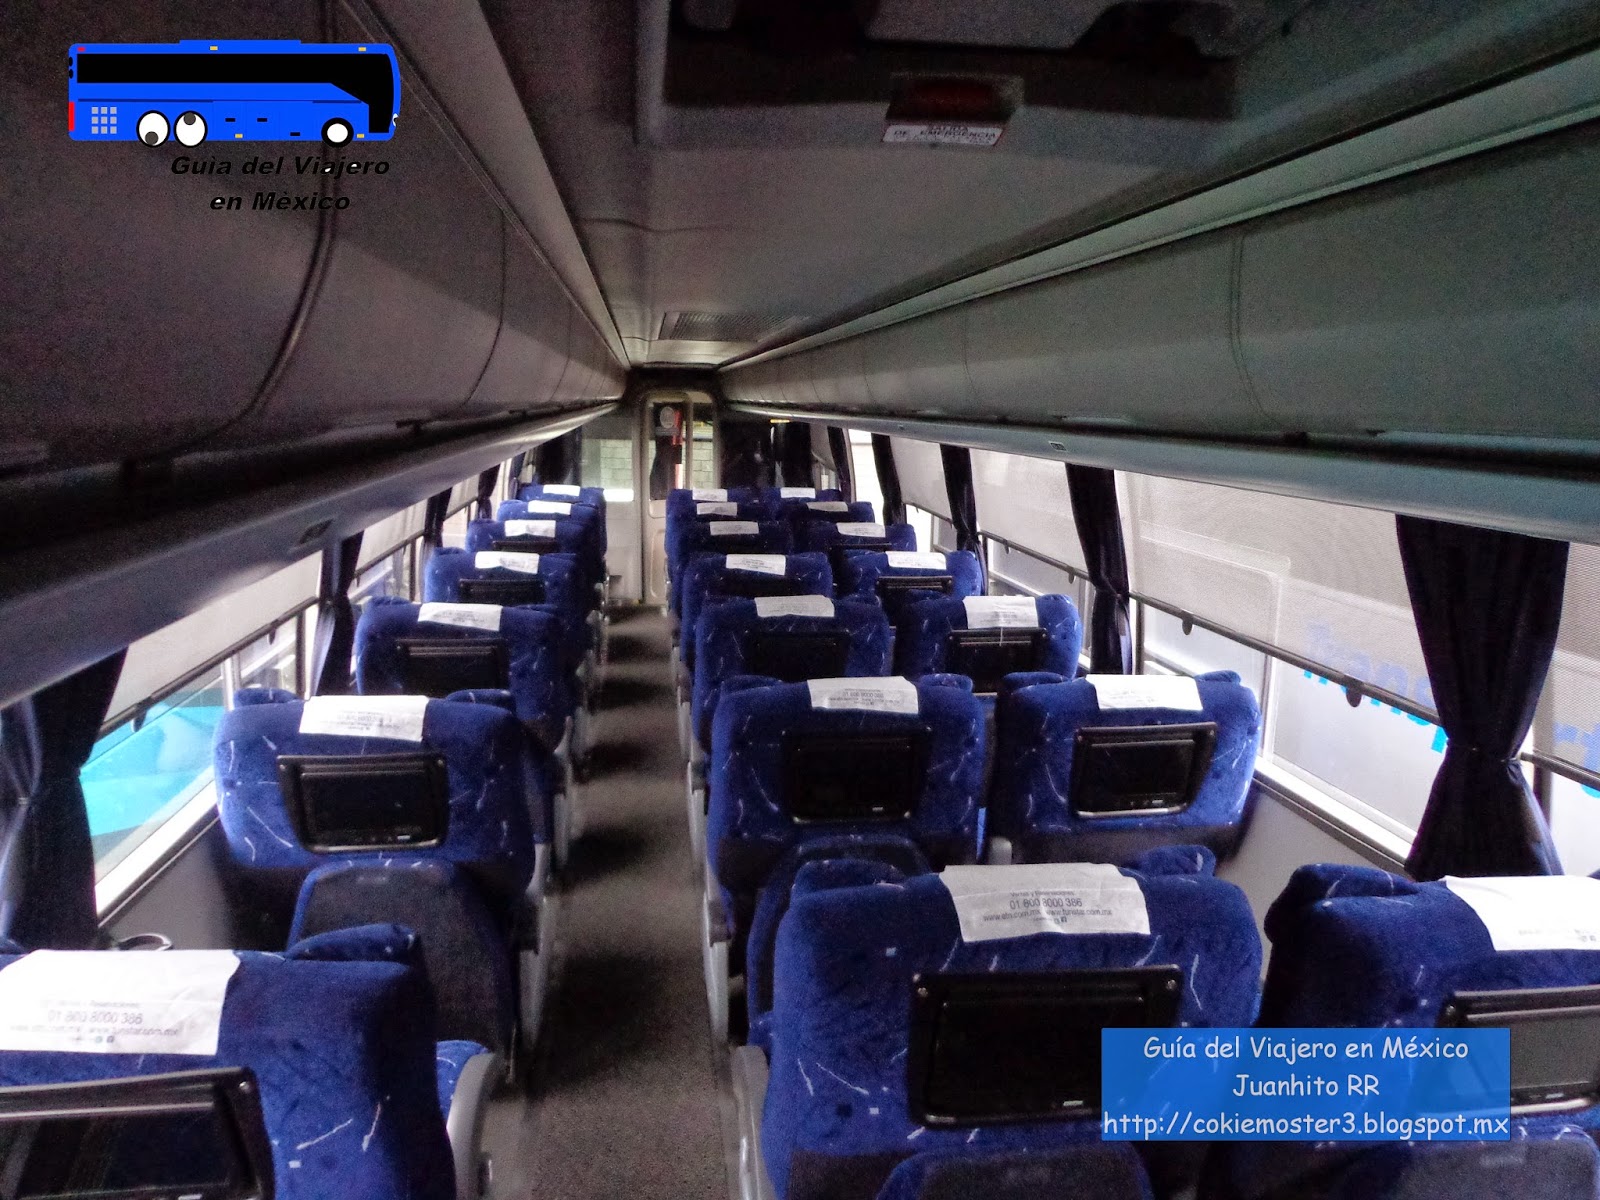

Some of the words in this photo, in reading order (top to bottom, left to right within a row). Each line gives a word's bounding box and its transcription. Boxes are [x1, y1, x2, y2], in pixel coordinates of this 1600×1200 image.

[1009, 900, 1020, 909] 01
[1023, 899, 1040, 908] 800
[1042, 898, 1064, 907] 8000
[1065, 898, 1083, 907] 386
[64, 1010, 88, 1023] 800
[89, 1011, 118, 1025] 8000
[120, 1012, 143, 1025] 386
